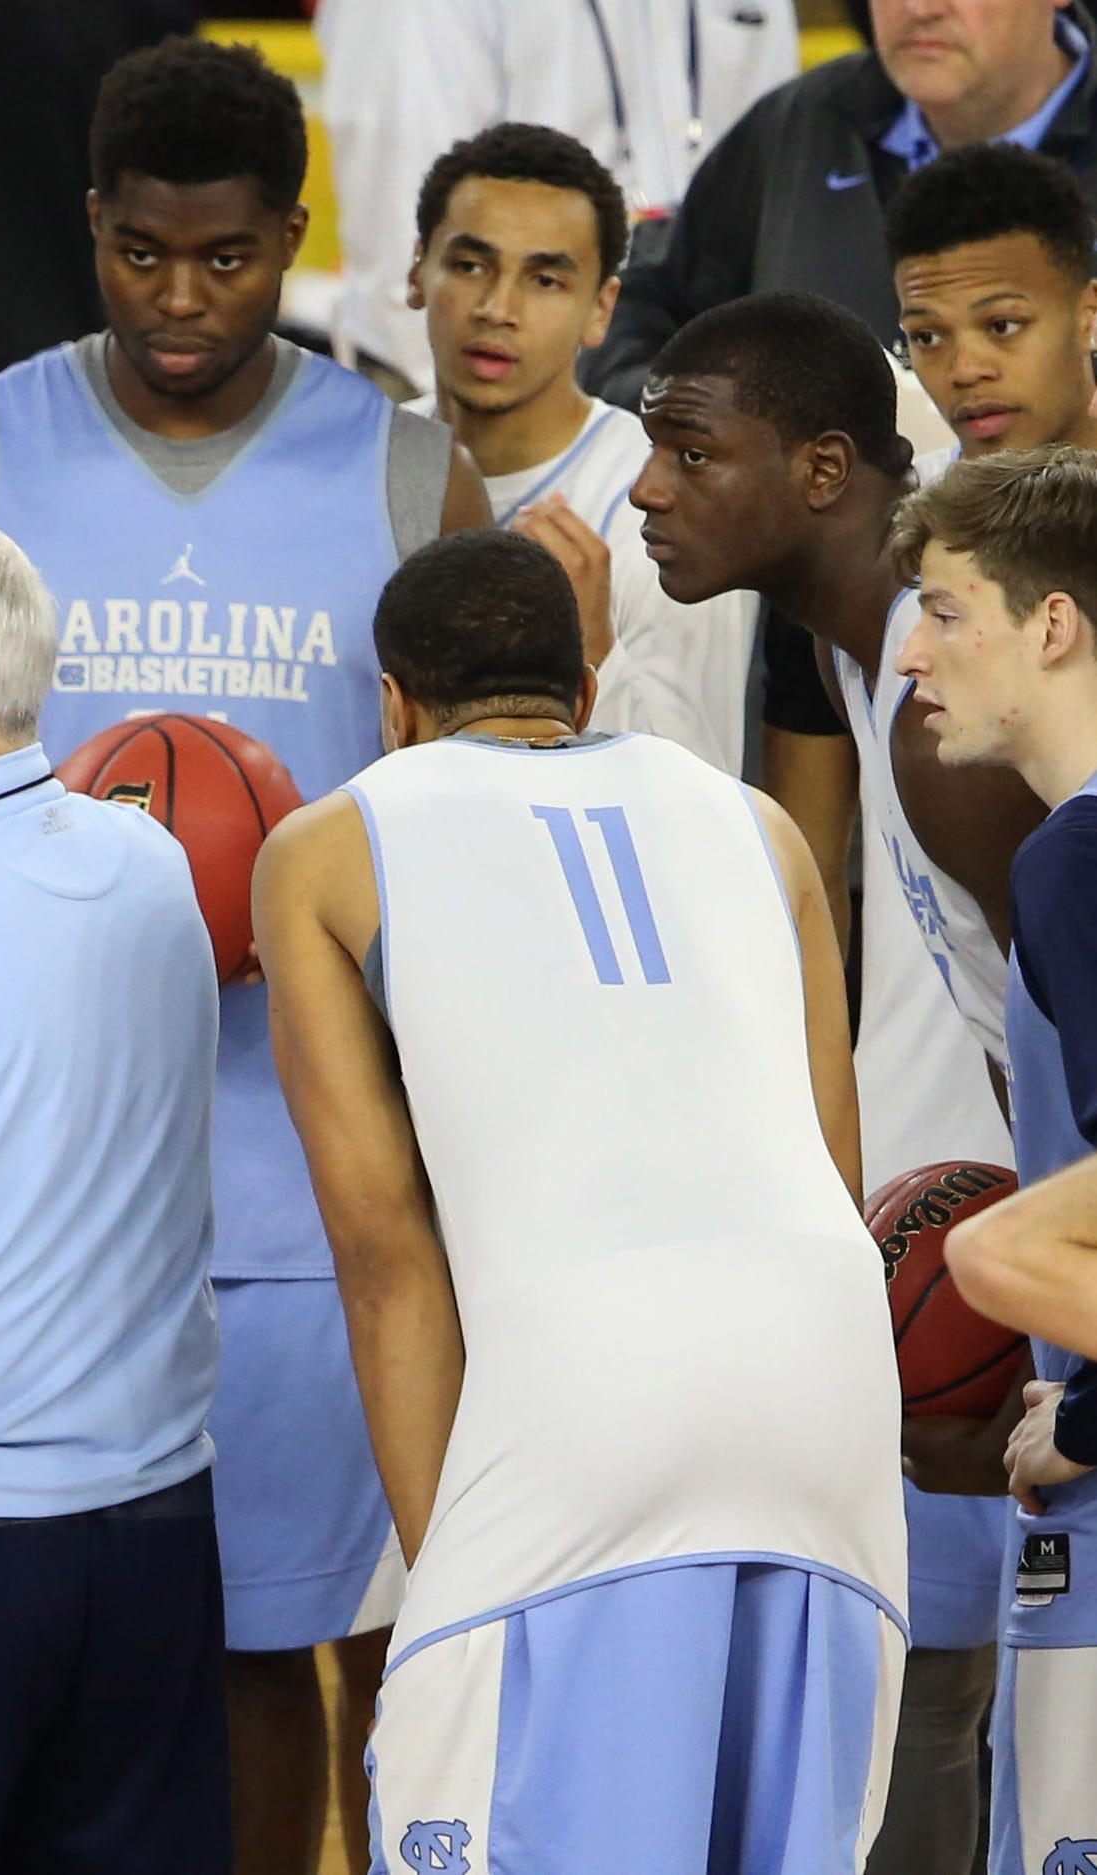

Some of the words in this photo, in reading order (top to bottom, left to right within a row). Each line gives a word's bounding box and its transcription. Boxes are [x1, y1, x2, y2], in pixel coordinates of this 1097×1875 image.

[58, 598, 338, 667] AROLINA
[90, 654, 310, 703] BASKETBALL
[530, 804, 673, 986] 11
[1039, 1539, 1056, 1556] M
